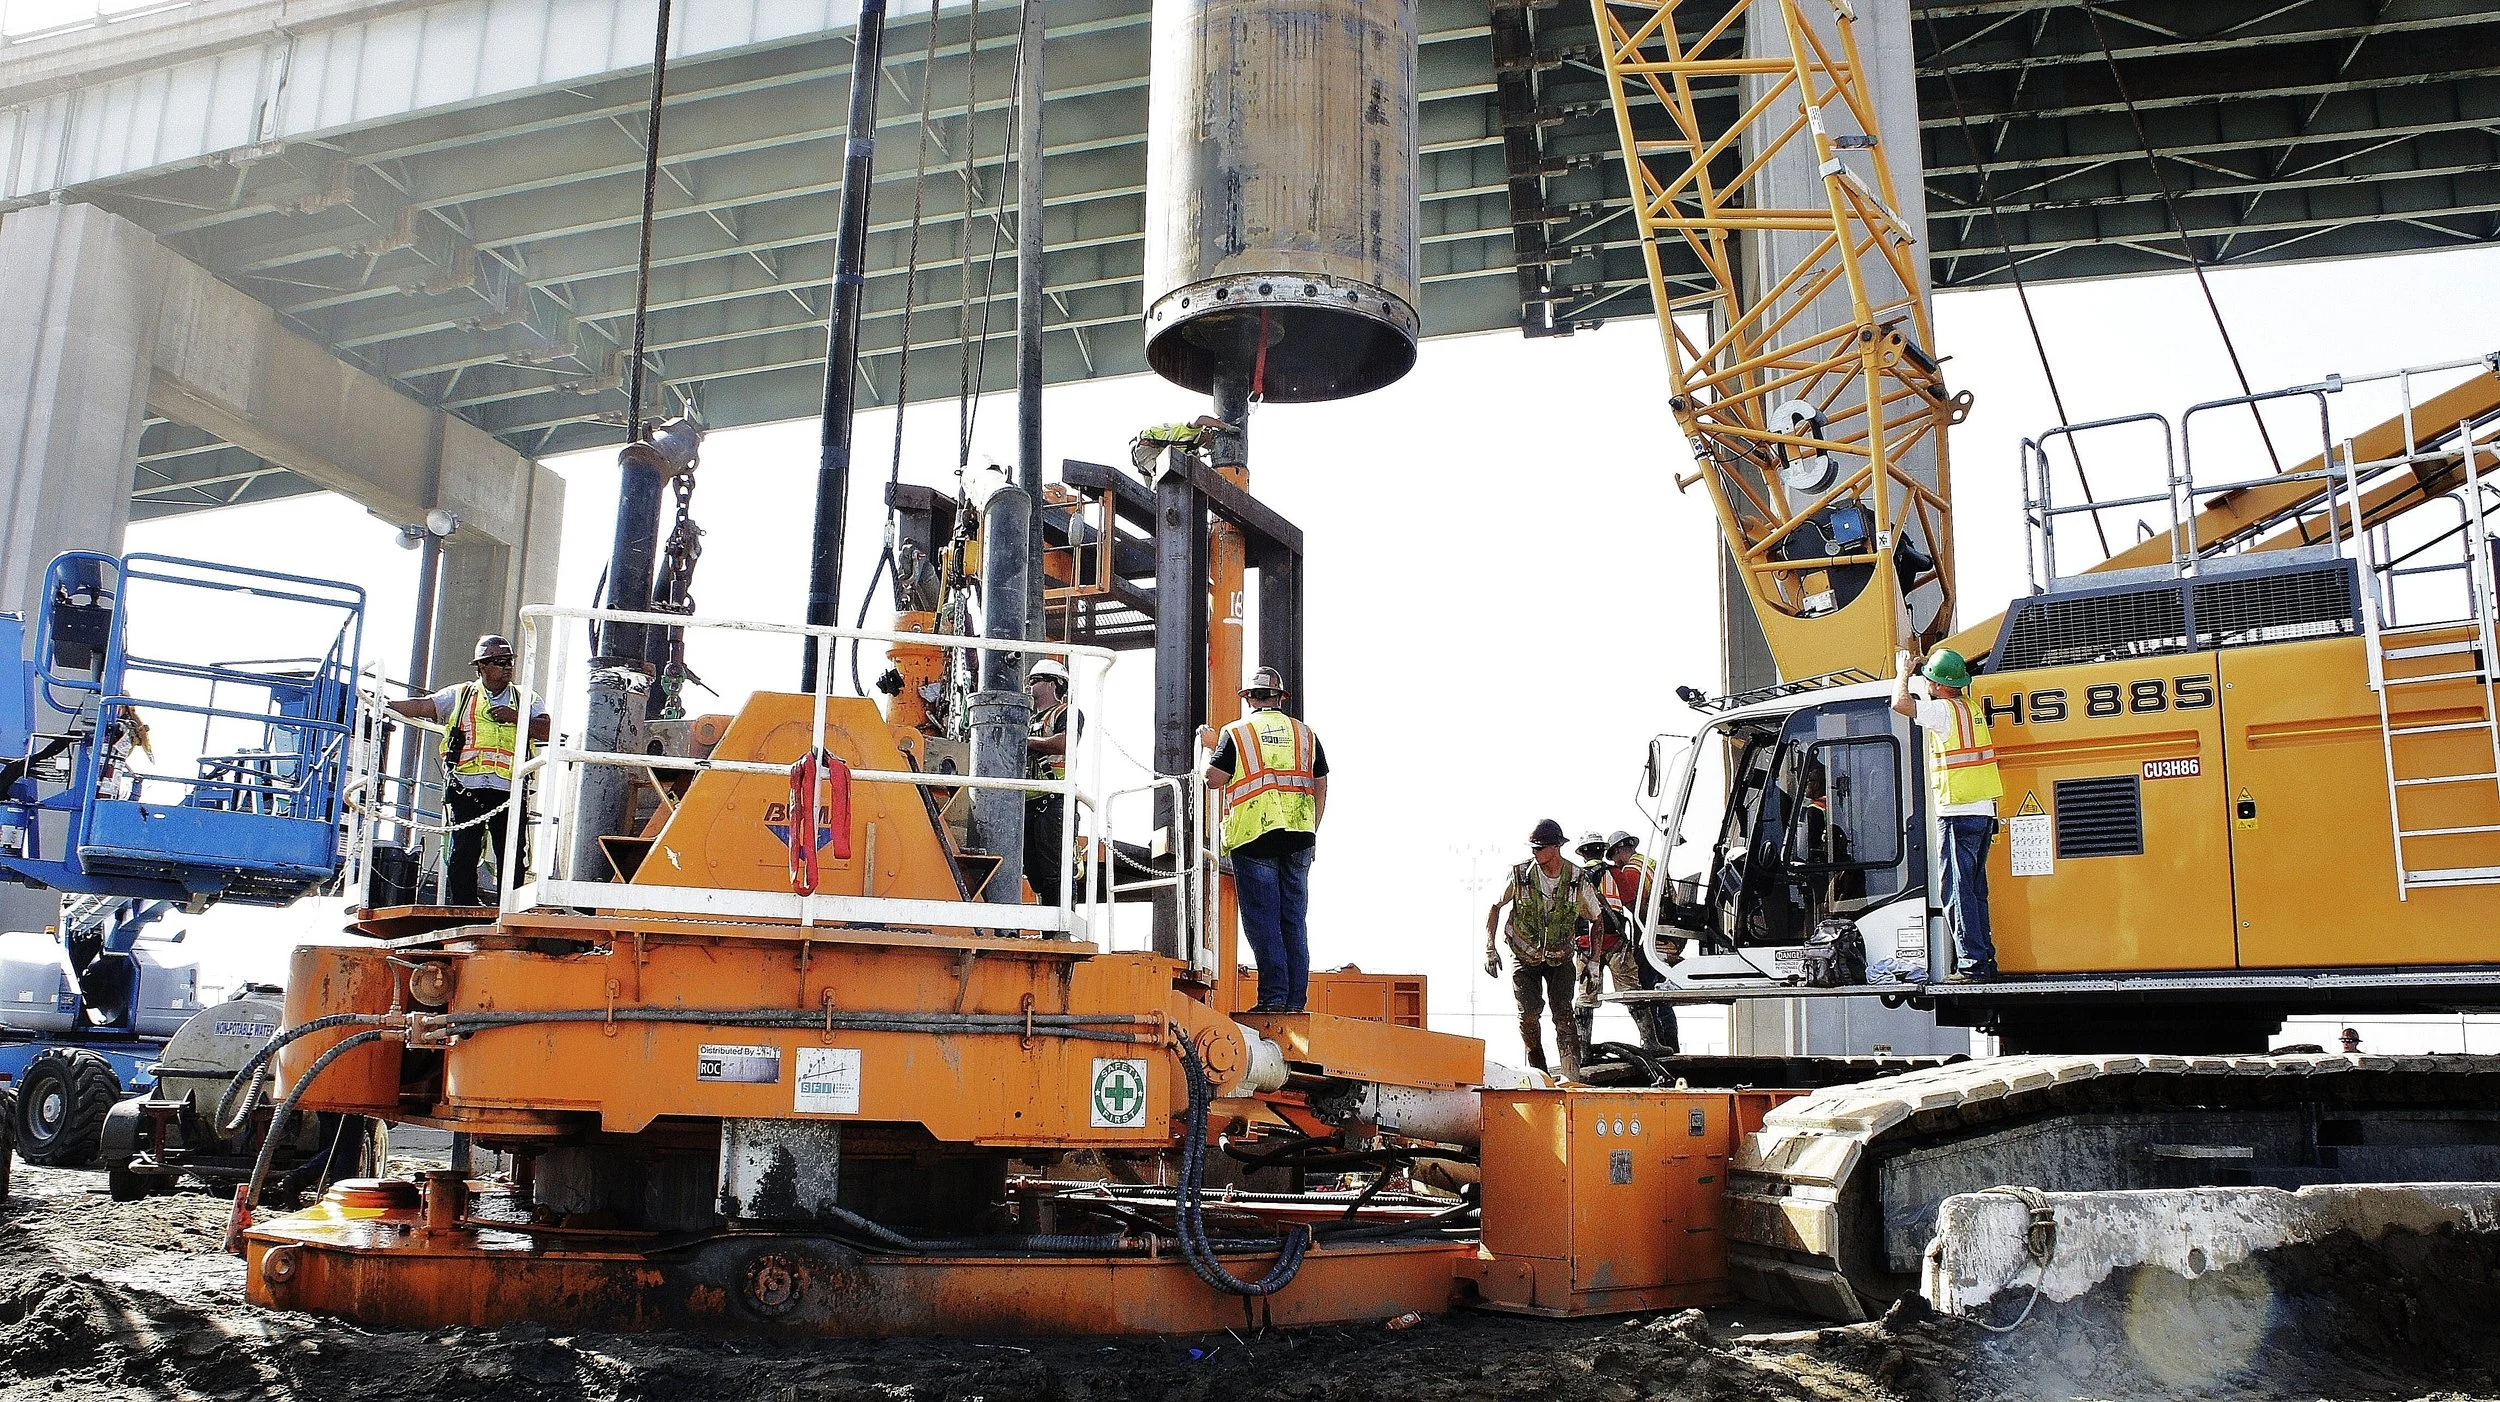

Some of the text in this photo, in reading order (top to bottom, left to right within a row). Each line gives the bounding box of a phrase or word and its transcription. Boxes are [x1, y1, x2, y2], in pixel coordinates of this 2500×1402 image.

[1982, 674, 2214, 728] HS 885
[2144, 759, 2199, 778] CU3H86
[701, 1046, 743, 1056] Distributed
[744, 1047, 754, 1057] By
[701, 1062, 721, 1075] ROC
[1101, 1063, 1140, 1081] SAFETY
[802, 1082, 831, 1093] SFI
[1102, 1109, 1136, 1124] FIRST
